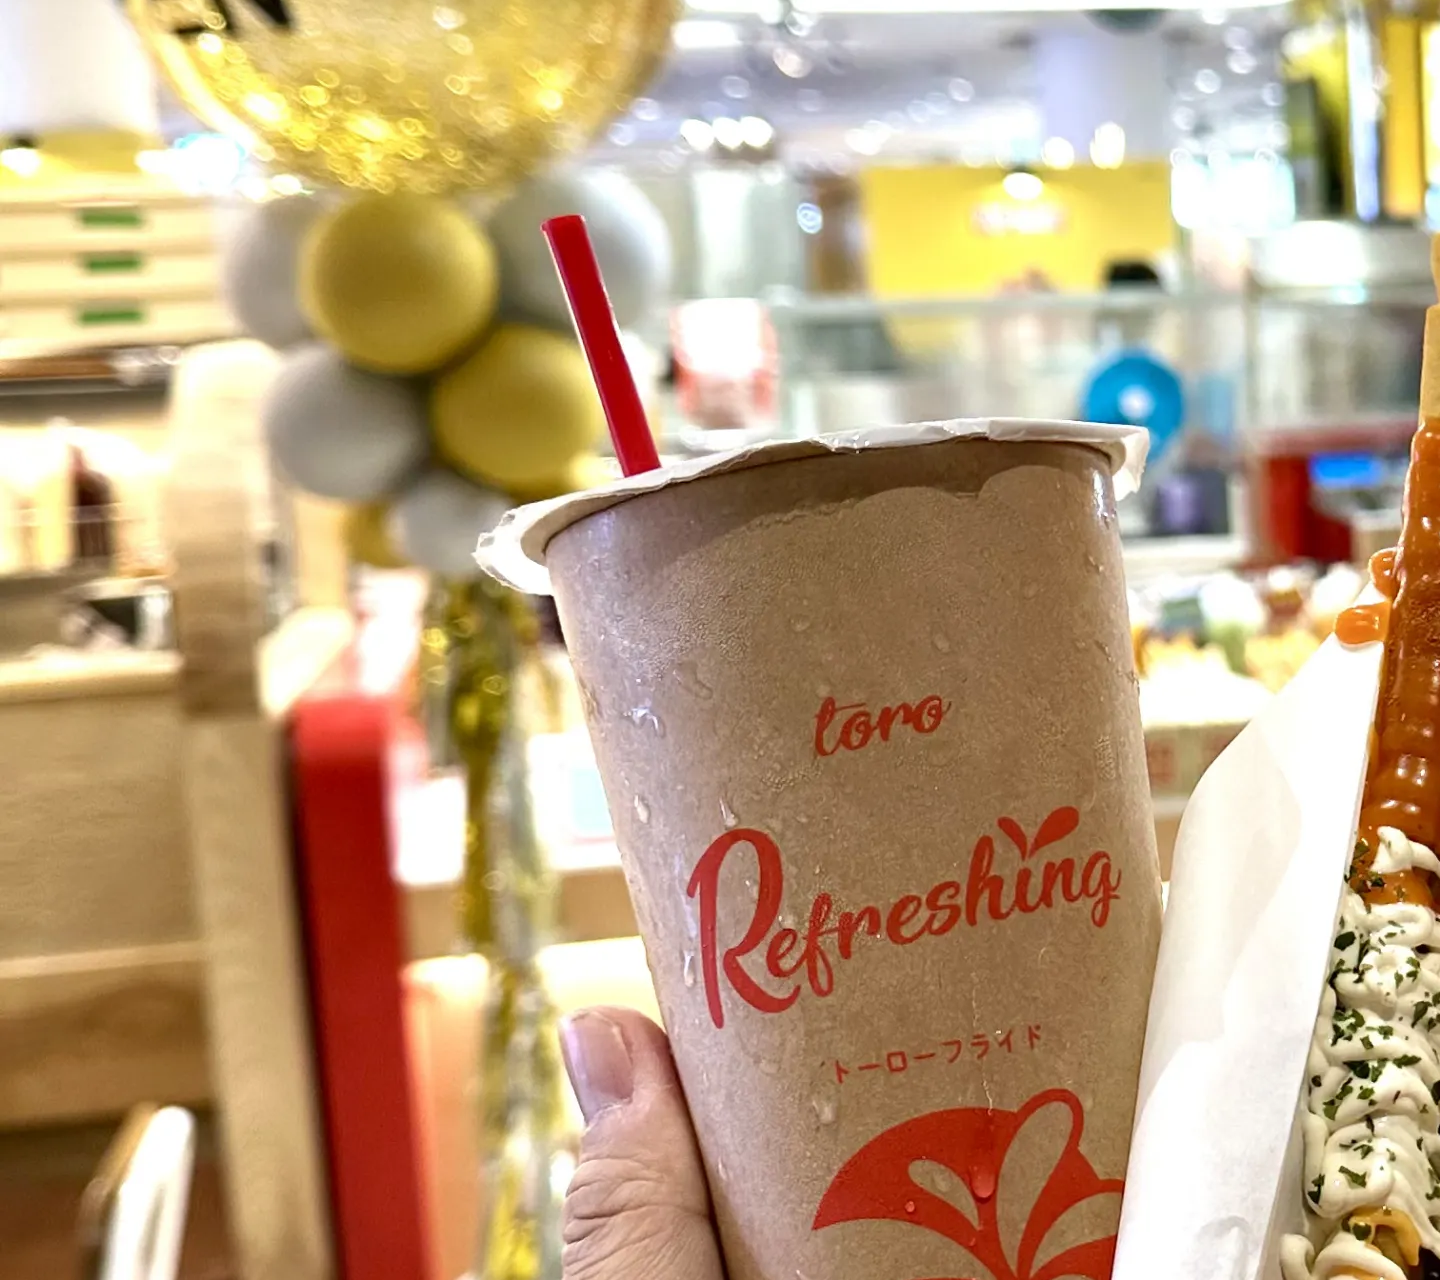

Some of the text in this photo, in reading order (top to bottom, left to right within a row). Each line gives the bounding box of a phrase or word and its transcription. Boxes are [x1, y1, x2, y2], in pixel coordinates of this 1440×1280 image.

[814, 694, 951, 756] toro
[687, 806, 1121, 1029] Refreshing
[832, 1022, 1044, 1085] トーローフライド
